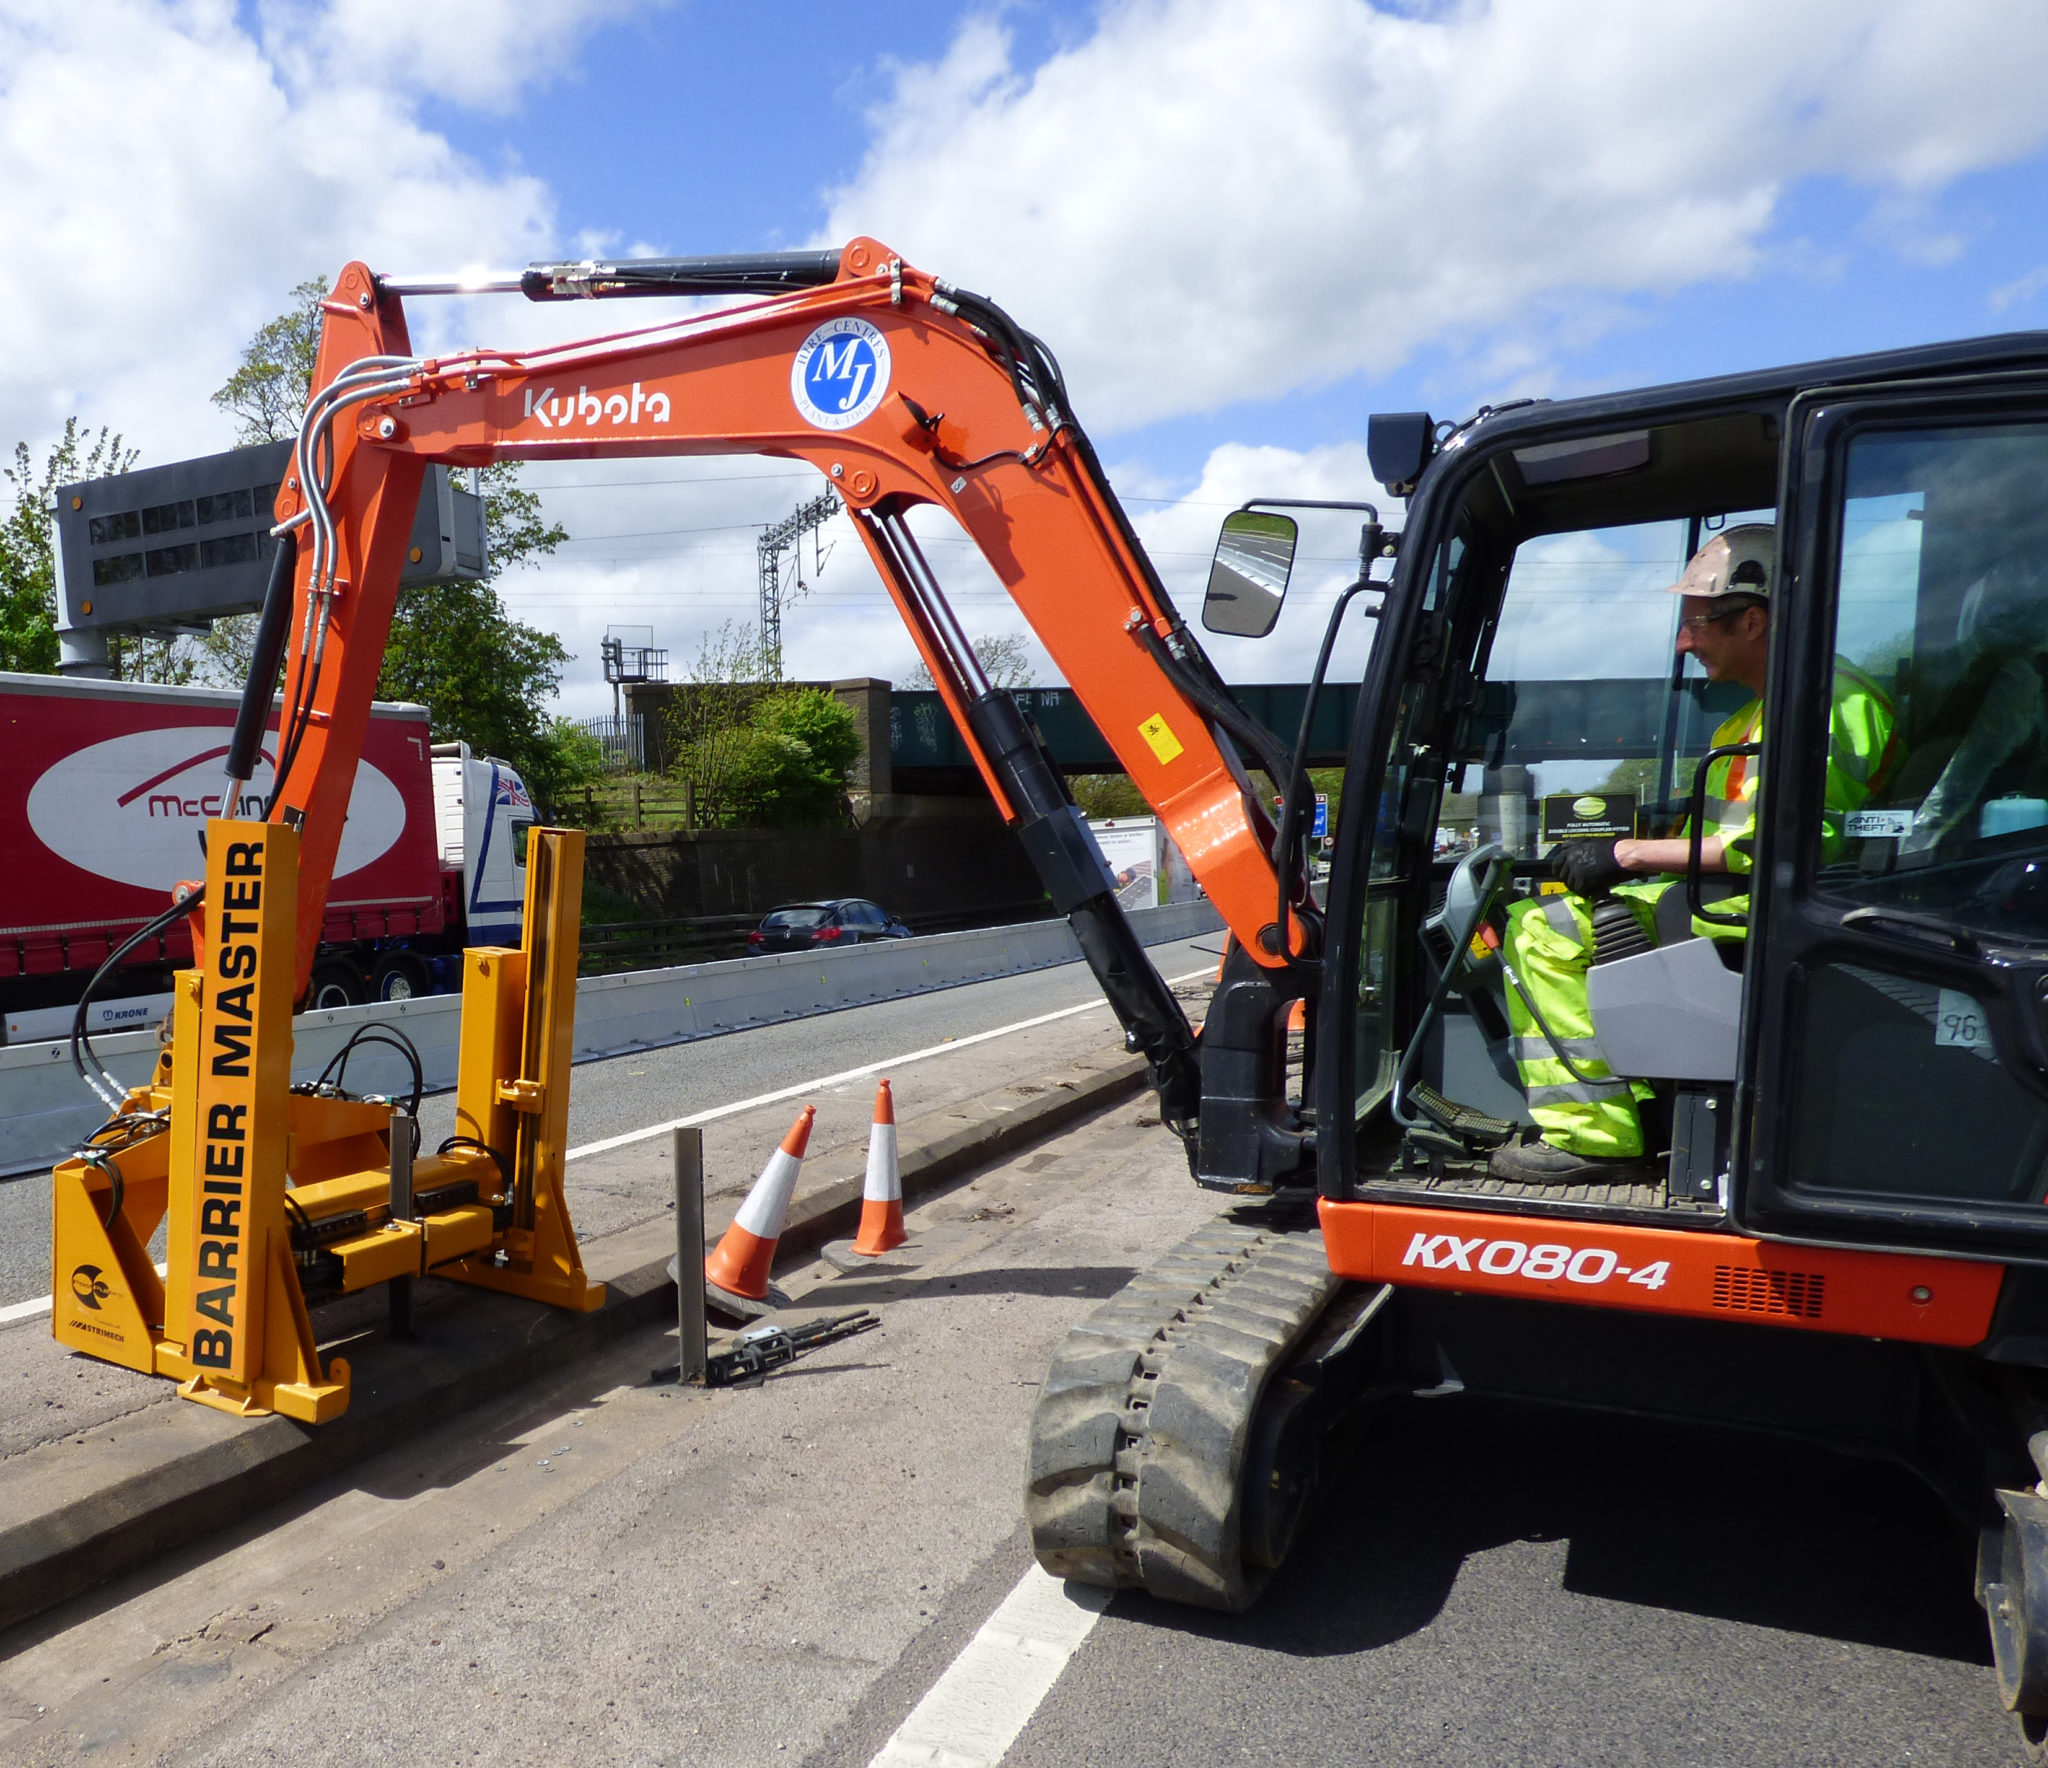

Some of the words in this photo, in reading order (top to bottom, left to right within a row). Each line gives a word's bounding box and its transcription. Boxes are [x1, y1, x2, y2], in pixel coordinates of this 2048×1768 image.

[798, 329, 825, 365] HIRE
[834, 320, 887, 359] CENTRES
[524, 382, 671, 428] Kubota
[1847, 824, 1886, 832] THEFT
[212, 841, 265, 1077] MASTER
[114, 1007, 149, 1020] KRONE
[192, 1103, 247, 1369] BARRIER
[1402, 1232, 1671, 1290] KX080-4
